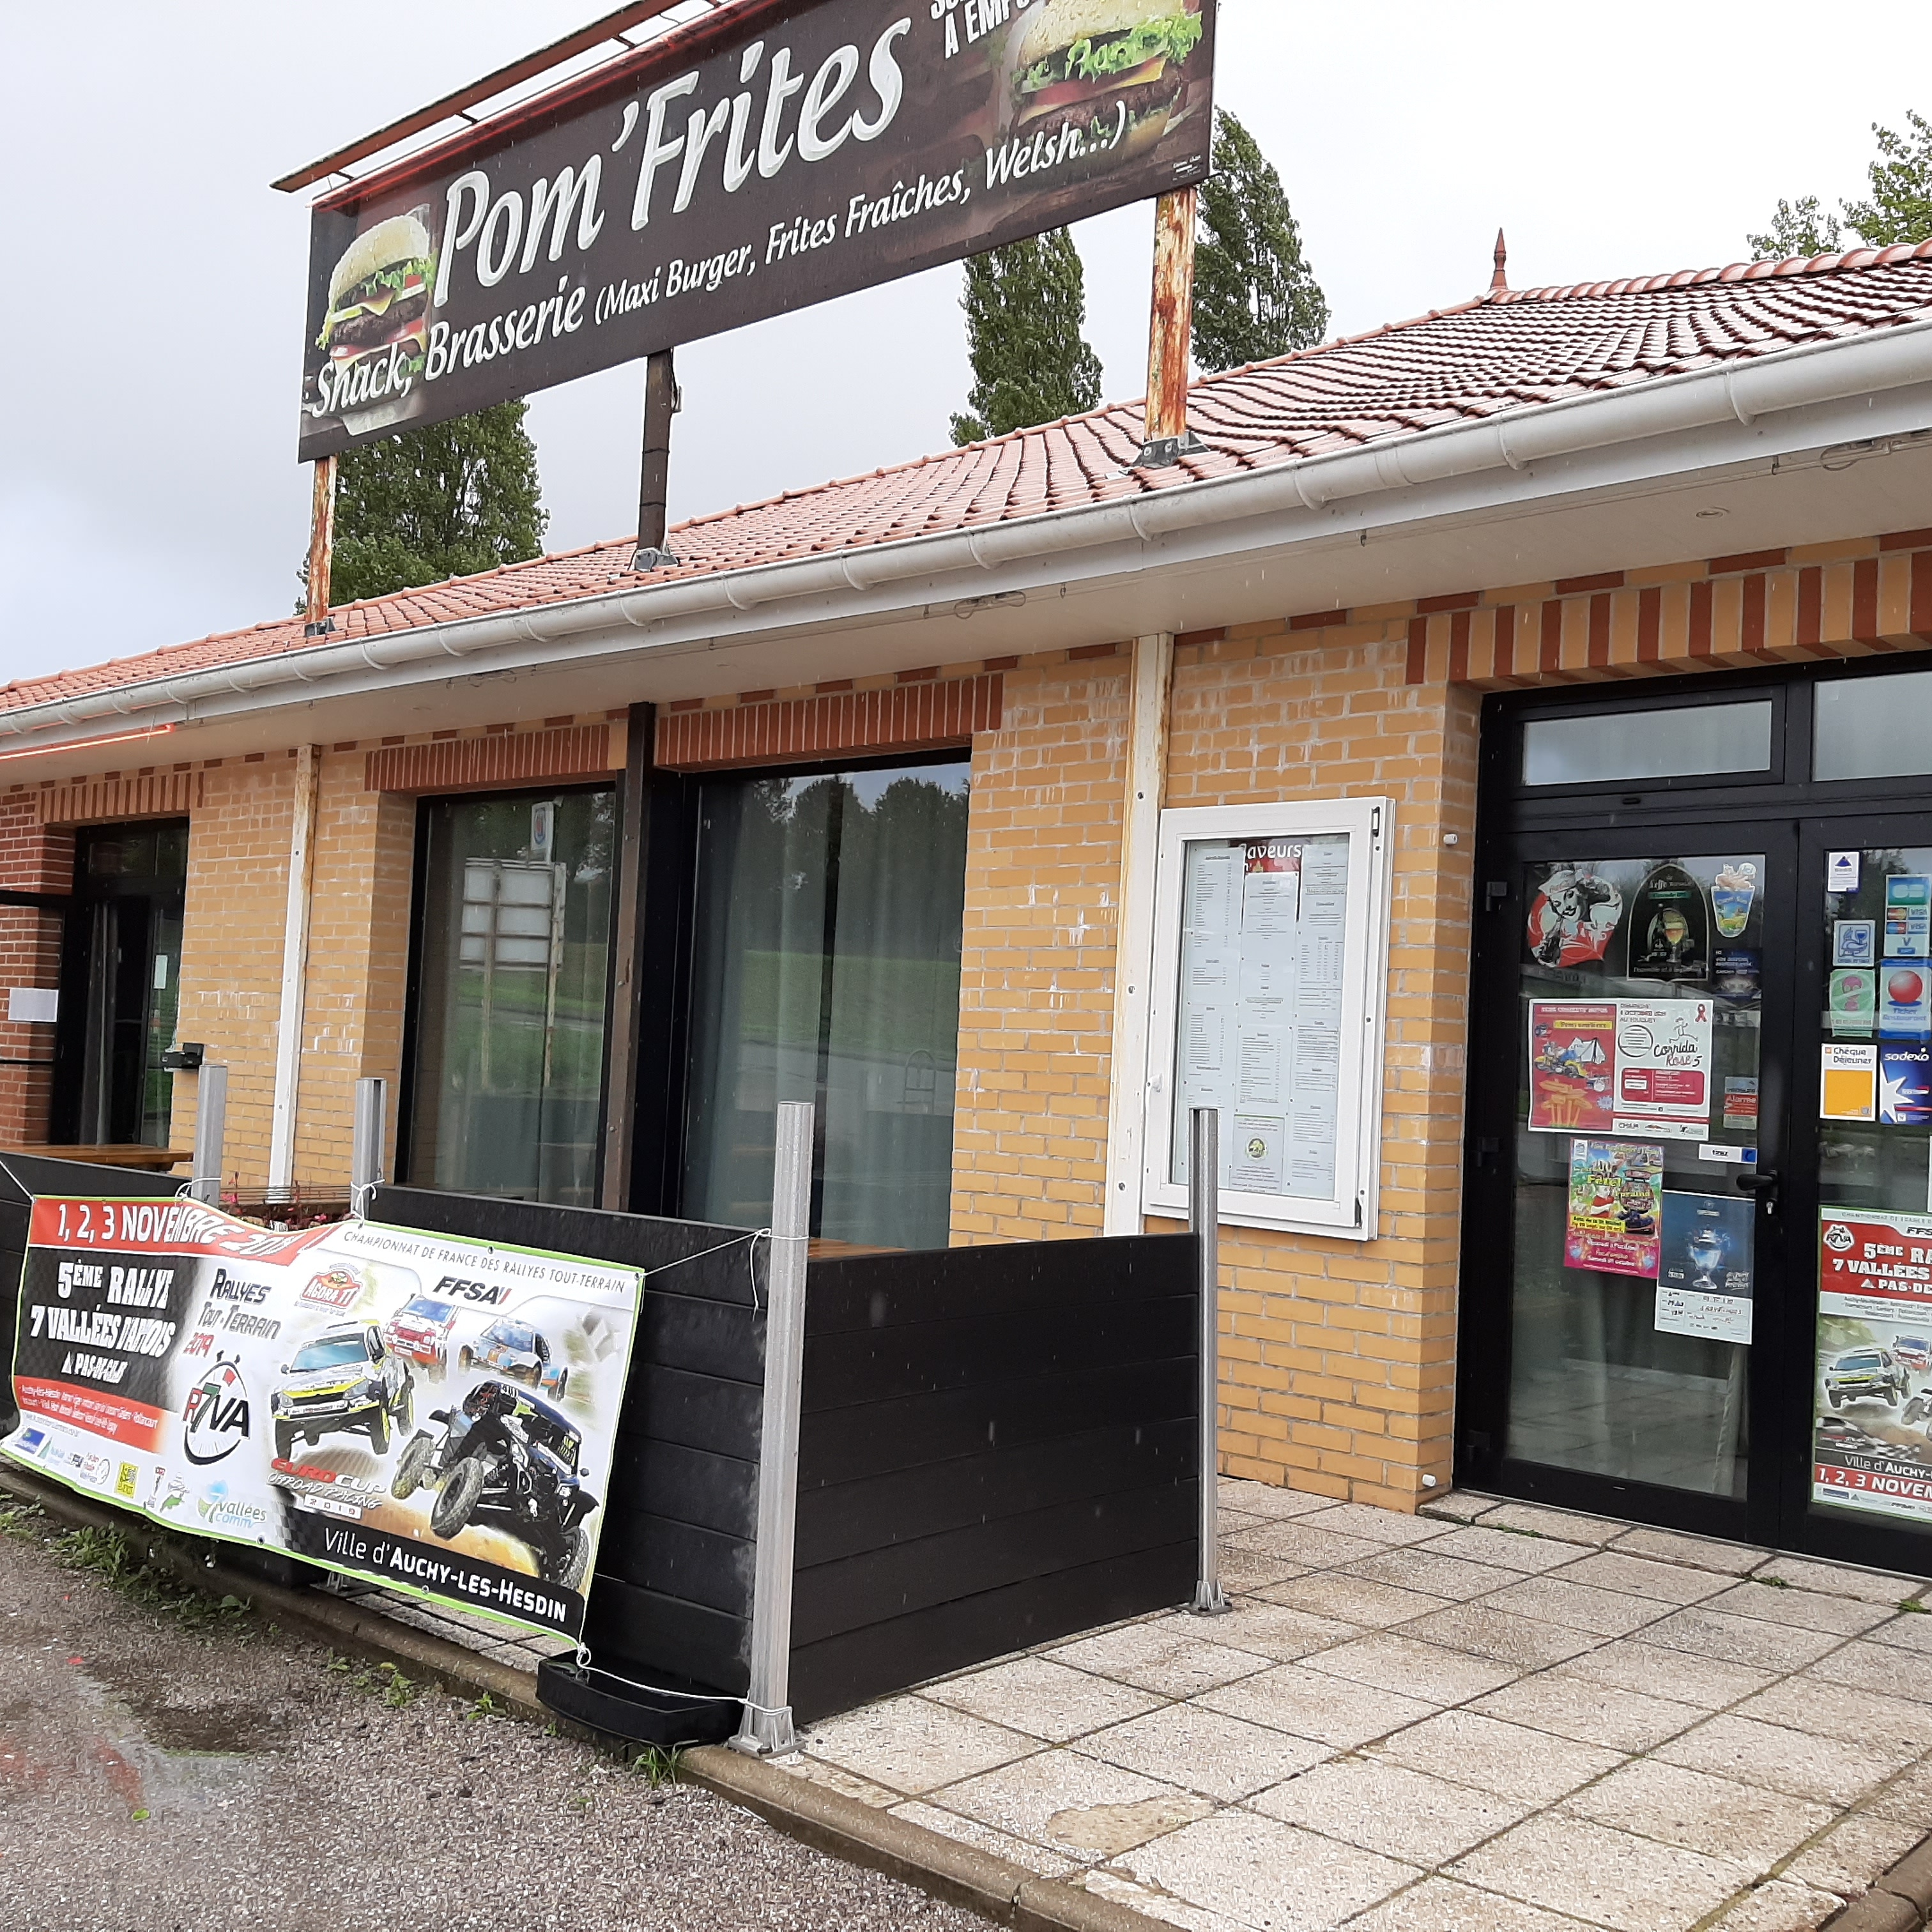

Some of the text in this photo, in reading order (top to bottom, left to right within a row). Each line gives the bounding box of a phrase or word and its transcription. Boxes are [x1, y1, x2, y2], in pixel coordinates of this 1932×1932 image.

[433, 154, 605, 308] Pom
[312, 346, 413, 418] Snack,
[424, 275, 586, 382] Brasserie
[594, 268, 661, 325] (Maxi
[665, 243, 756, 298] Burger,
[765, 213, 837, 264] Frites
[845, 169, 971, 239] Fraîches,
[1246, 845, 1301, 859] aveurs
[1884, 1051, 1929, 1061] sodexo
[57, 1203, 71, 1243] 1,
[76, 1204, 95, 1243] 2,
[101, 1204, 116, 1241] 3
[343, 1230, 625, 1294] CHAMPIONNAT DE FRANCE DES RALLYES TOUT-TERRAIN
[1832, 1258, 1931, 1280] 7 VALLÉES
[432, 1275, 502, 1305] FFSA
[29, 1305, 46, 1337] 7
[47, 1304, 122, 1349] VALLÉES
[1819, 1468, 1830, 1483] 1,
[1834, 1470, 1850, 1487] 2,
[1854, 1473, 1867, 1487] 3
[1844, 1454, 1932, 1480] Ville d'AUCHY-
[324, 1527, 367, 1560] Ville
